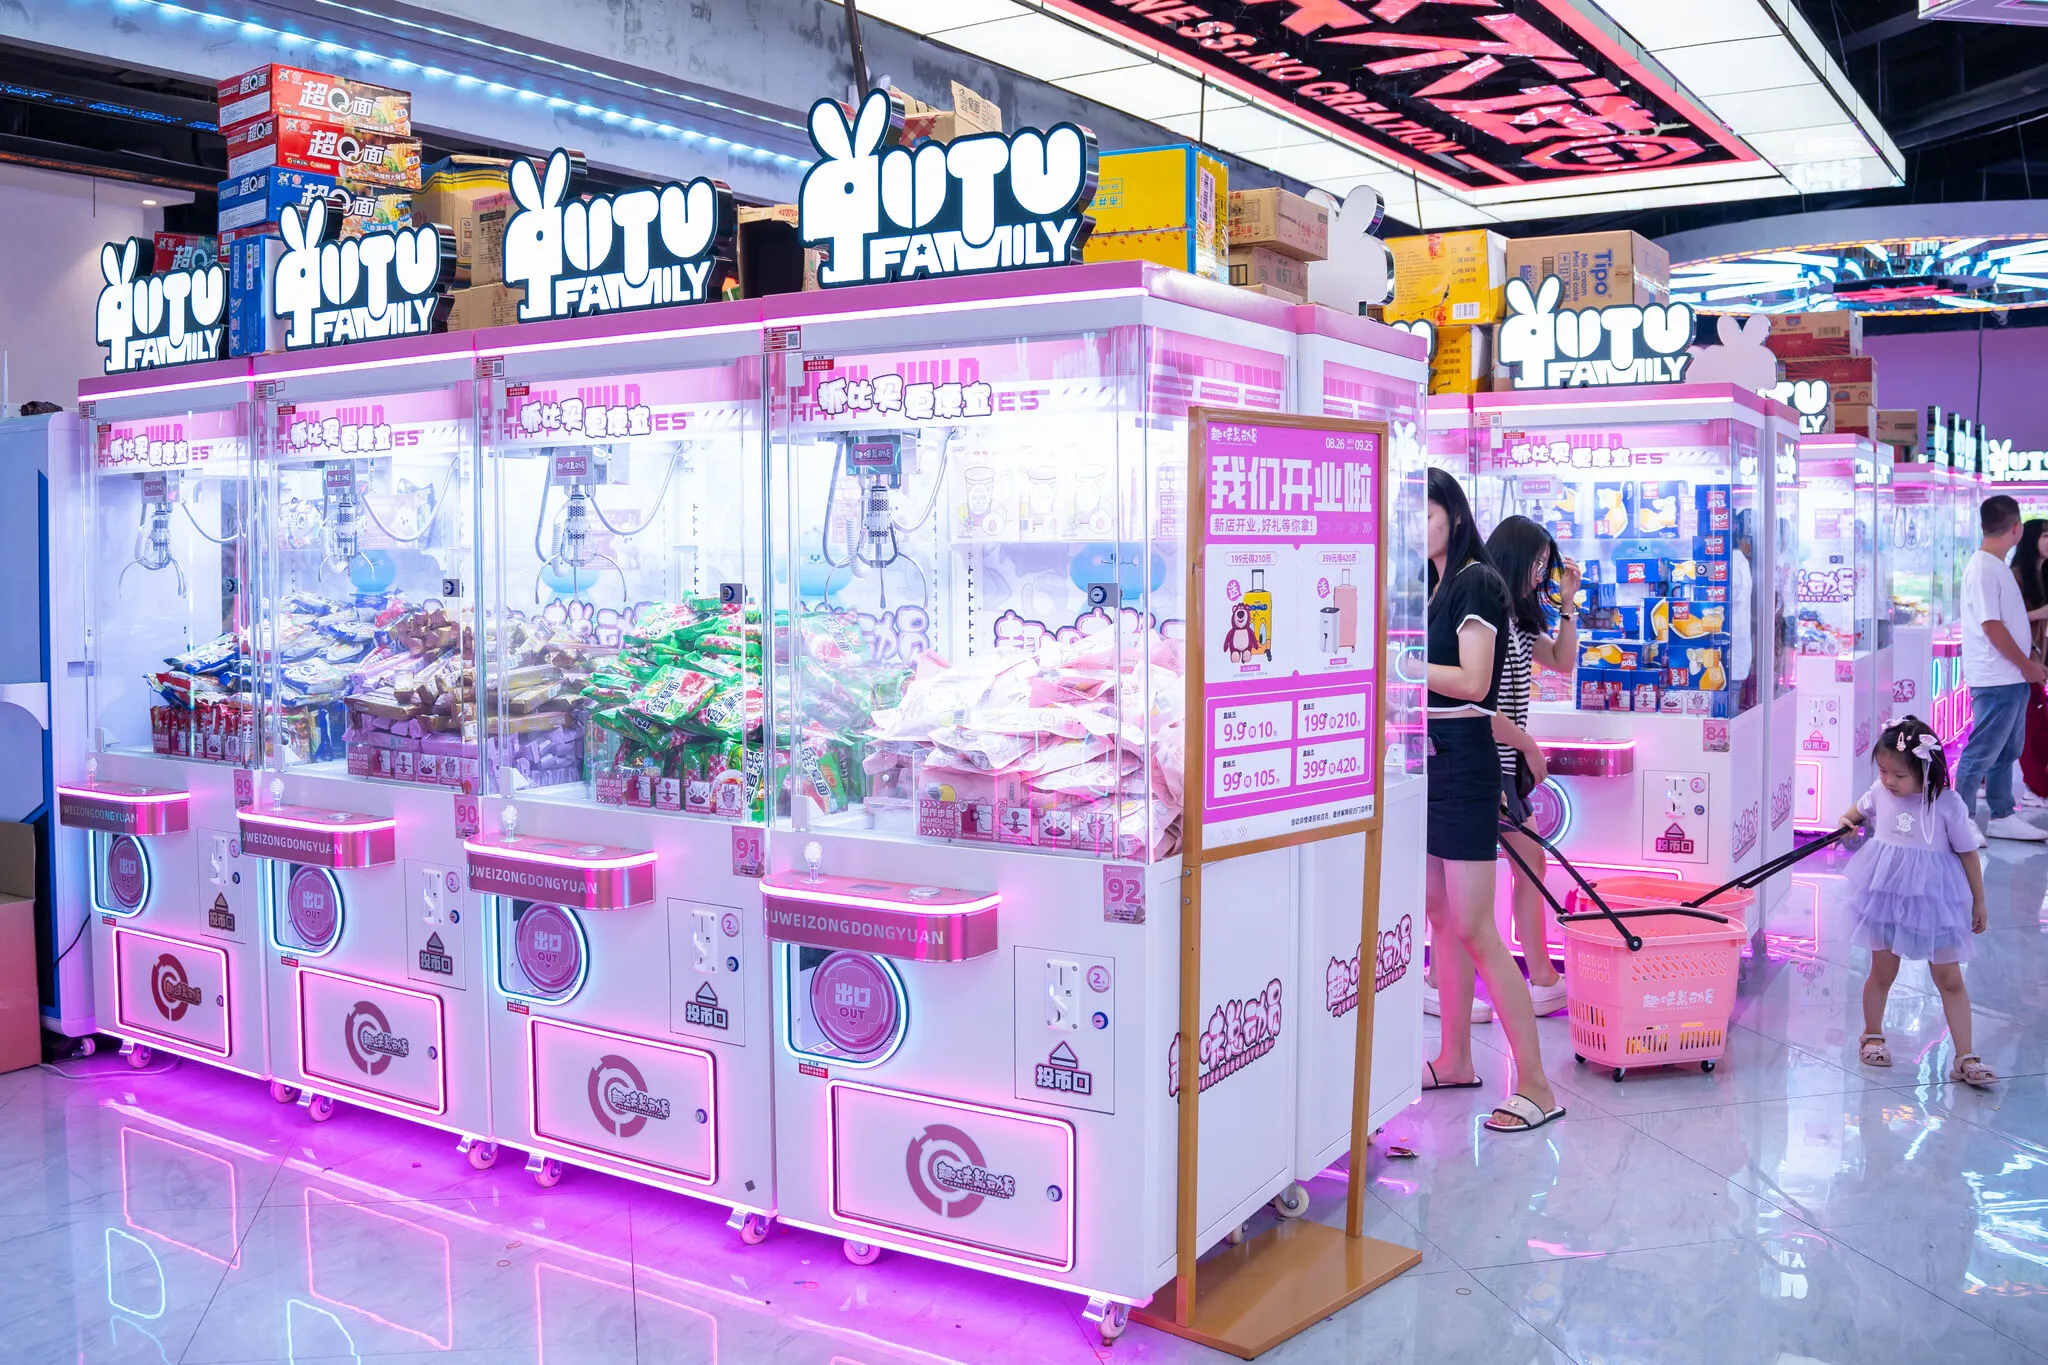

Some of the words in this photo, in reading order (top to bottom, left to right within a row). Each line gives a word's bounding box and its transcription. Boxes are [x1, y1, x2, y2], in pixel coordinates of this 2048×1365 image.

[239, 73, 267, 95] 超Q面
[298, 81, 374, 117] 超Q面
[1297, 81, 1467, 154] CREATION
[247, 120, 273, 143] 超Q面
[307, 130, 385, 164] 超Q面
[172, 245, 218, 270] 超Q
[870, 219, 1078, 279] FAMILY
[1590, 248, 1613, 296] Tipo
[555, 261, 711, 316] FAMILY
[315, 298, 436, 344] FAMILY
[127, 328, 221, 370] FAMILY
[1548, 356, 1688, 387] FAMILY
[817, 374, 992, 420] 抓比买更便宜
[521, 397, 650, 438] 抓比买更便宜
[1326, 437, 1345, 450] 08.26
[1354, 440, 1373, 451] 09.25
[1211, 455, 1372, 513] 我们开业啦
[1672, 605, 1689, 615] Tipo
[1621, 658, 1637, 667] Tipo
[1706, 726, 1728, 741] 84
[236, 778, 251, 796] 89
[456, 804, 478, 825] 90
[921, 817, 954, 825] HANDLING
[736, 838, 760, 860] 91
[1656, 837, 1694, 854] 投币口
[122, 874, 135, 883] OUT
[303, 890, 324, 909] 出口
[1107, 878, 1141, 905] 92
[305, 908, 321, 920] OUT
[534, 930, 562, 952] 出口
[419, 949, 453, 976] 投币口
[537, 951, 558, 964] OUT
[835, 982, 870, 1007] 出口
[686, 1002, 729, 1029] 投币口
[839, 1006, 866, 1021] OUT
[1035, 1063, 1092, 1096] 投币口
